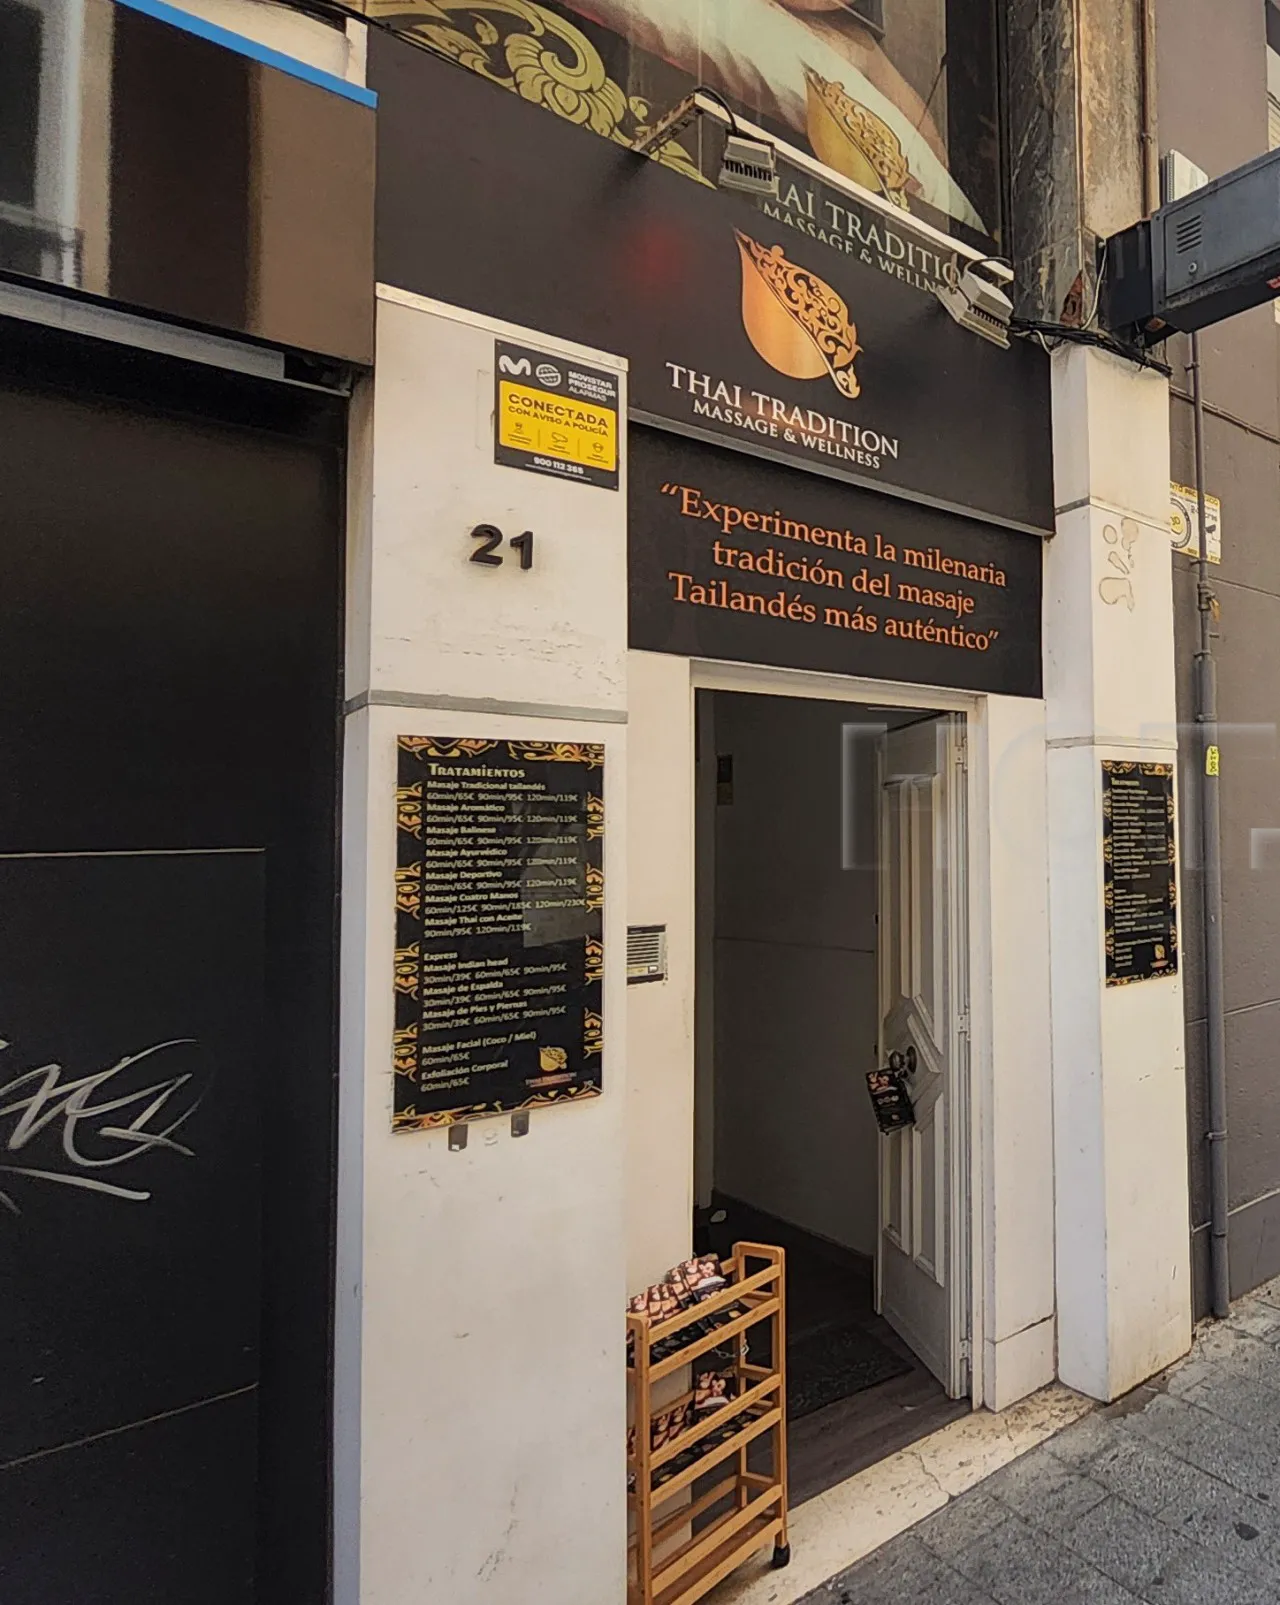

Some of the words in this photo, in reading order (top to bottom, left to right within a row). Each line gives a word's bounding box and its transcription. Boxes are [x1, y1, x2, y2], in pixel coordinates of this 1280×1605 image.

[825, 200, 962, 287] TRADITIO
[568, 371, 612, 389] MOVISTAR
[568, 378, 616, 398] PROSEGUR
[568, 386, 607, 402] ALARMAS
[509, 394, 608, 428] CONECTADA
[665, 362, 742, 408] THAI
[752, 390, 899, 459] TRADITION
[509, 406, 530, 416] CON
[533, 411, 562, 424] AVISO
[572, 422, 609, 438] POLICÍA
[693, 400, 778, 438] MASSAGE
[784, 428, 797, 444] &
[801, 432, 881, 469] WELLNESS
[534, 457, 550, 467] 900
[469, 524, 534, 570] 21
[875, 533, 897, 563] la
[903, 547, 1007, 587] milenaria
[713, 540, 844, 589] tradición
[851, 569, 891, 599] del
[897, 582, 975, 619] masaje
[669, 572, 817, 623] Tailandés
[824, 601, 878, 633] más
[427, 781, 459, 790] Masaje
[461, 781, 507, 790] Tradicional
[427, 804, 459, 812] Masaje
[426, 826, 459, 834] Masaje
[426, 849, 458, 857] Masaje
[426, 872, 458, 880] Masaje
[460, 871, 502, 879] Deportivo
[425, 895, 458, 903] Masaje
[425, 918, 457, 926] Masaje
[424, 952, 458, 961] Express
[424, 963, 456, 971] Masaje
[458, 961, 485, 969] Indian
[487, 958, 508, 966] head
[424, 987, 455, 995] Masaje
[471, 982, 503, 991] Espalda
[423, 1010, 455, 1018] Masaje
[490, 1005, 495, 1013] y
[497, 1002, 527, 1010] Piernas
[422, 1044, 454, 1053] Masaje
[457, 1039, 481, 1049] Facial
[483, 1037, 506, 1047] (Coco
[421, 1068, 470, 1080] Exfoliación
[472, 1060, 508, 1072] Corporal
